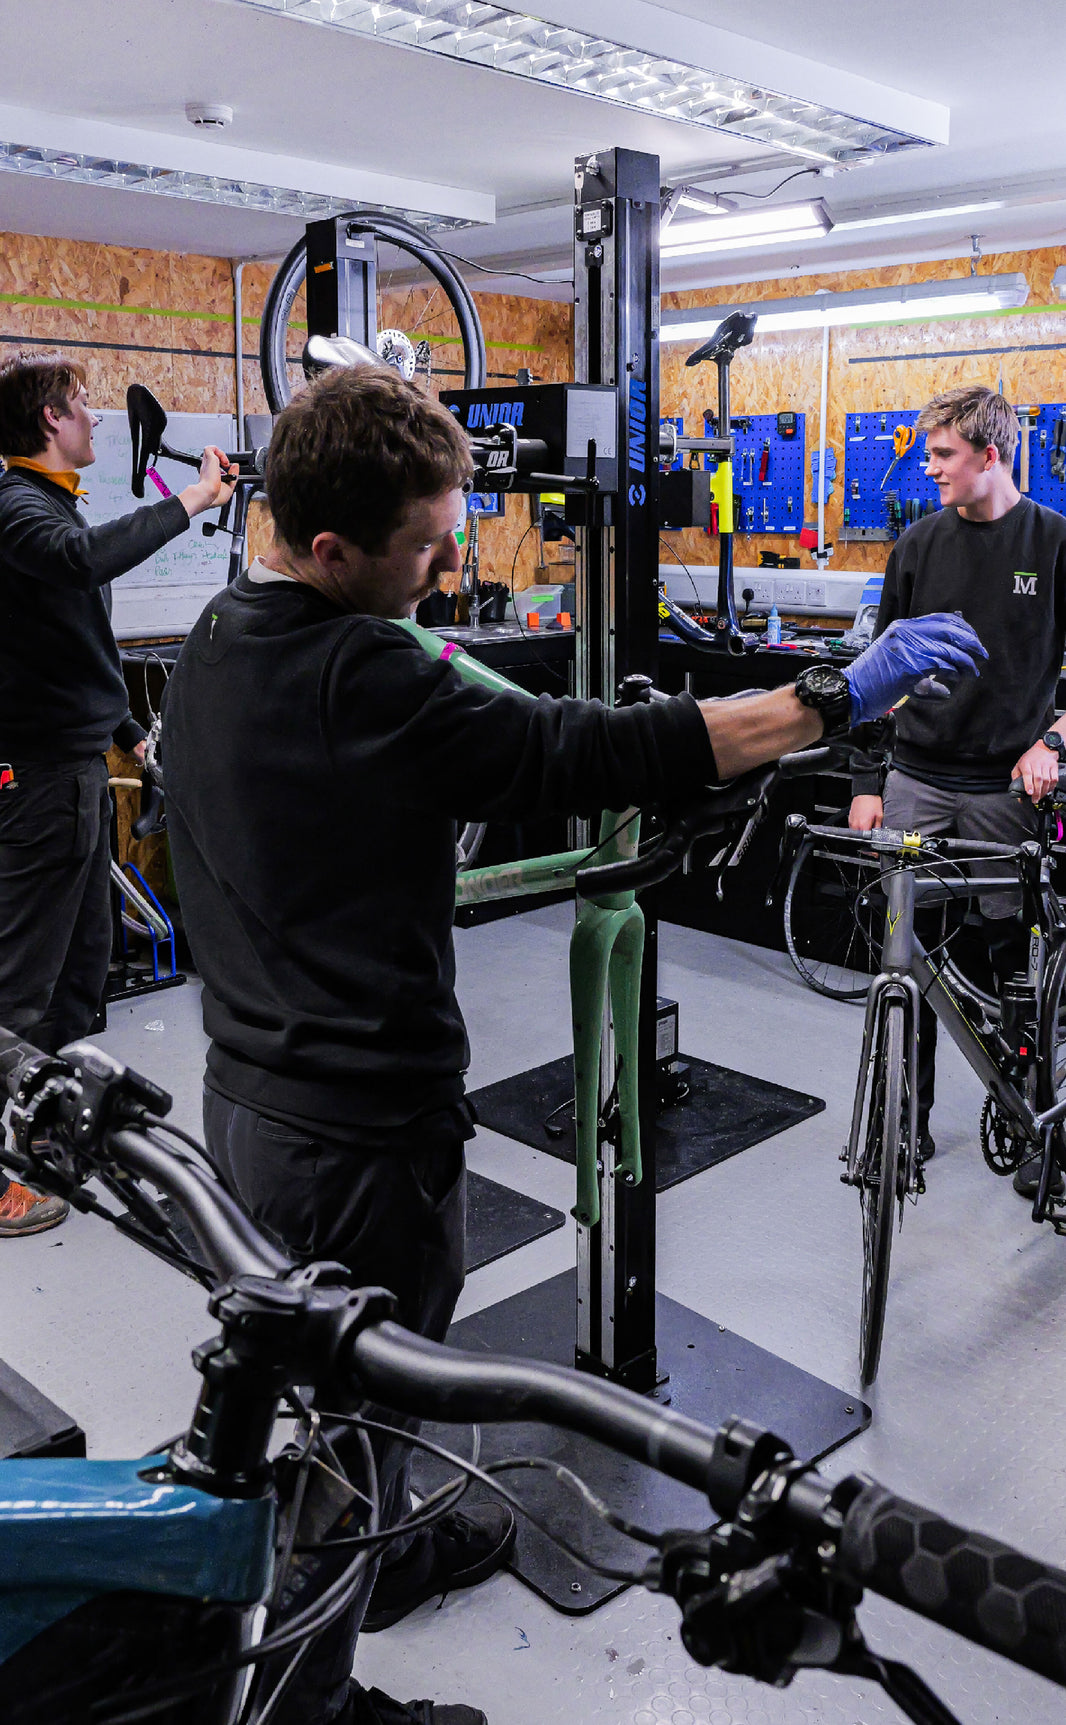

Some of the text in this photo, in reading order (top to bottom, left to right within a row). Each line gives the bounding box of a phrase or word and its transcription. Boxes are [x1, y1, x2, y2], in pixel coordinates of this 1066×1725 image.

[467, 402, 524, 428] UNIOR
[629, 378, 647, 473] UNIOR
[1013, 575, 1038, 596] M
